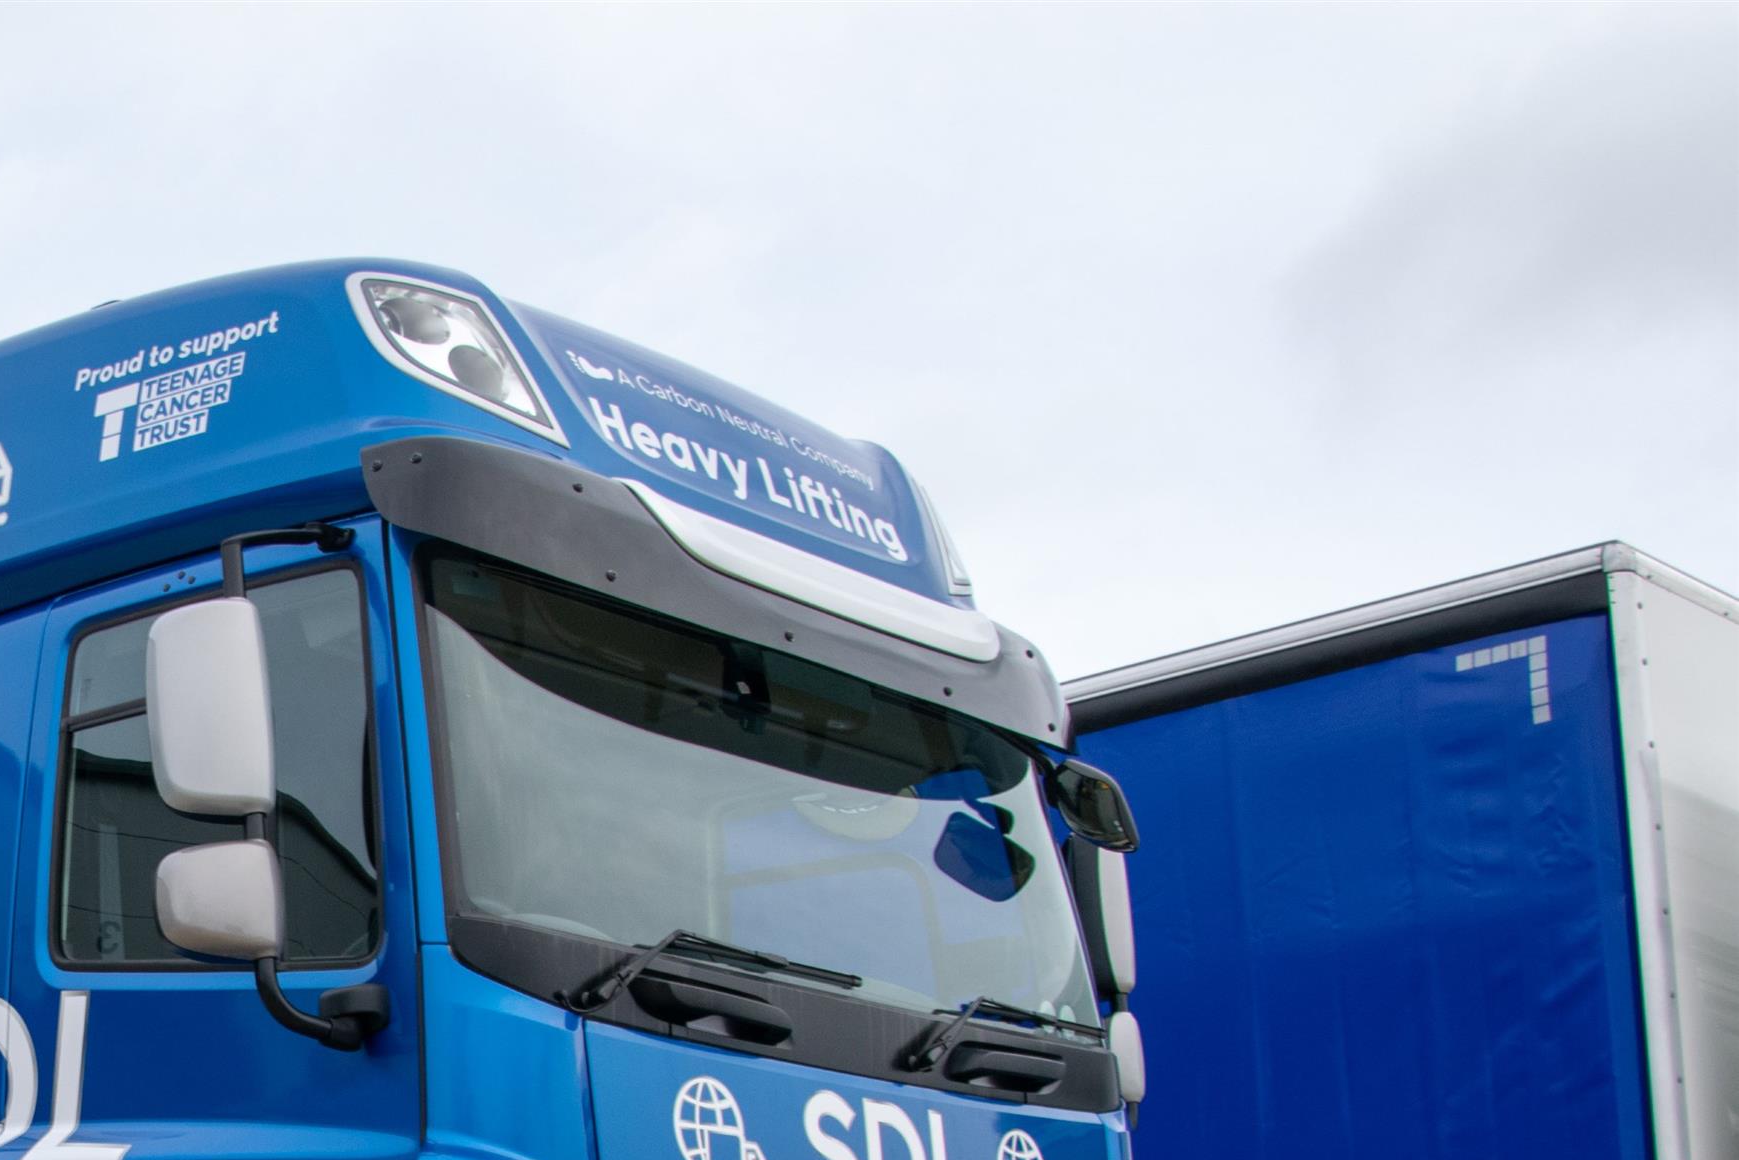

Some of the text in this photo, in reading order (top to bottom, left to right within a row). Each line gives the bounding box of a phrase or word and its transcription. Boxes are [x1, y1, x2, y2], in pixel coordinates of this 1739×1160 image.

[75, 311, 279, 391] Proud to support
[145, 355, 243, 398] TEENAGE
[138, 412, 205, 447] TRUST
[140, 383, 228, 423] CANCER
[617, 368, 874, 491] A Carbon Neutral Company
[589, 397, 908, 562] Heavy Lifting
